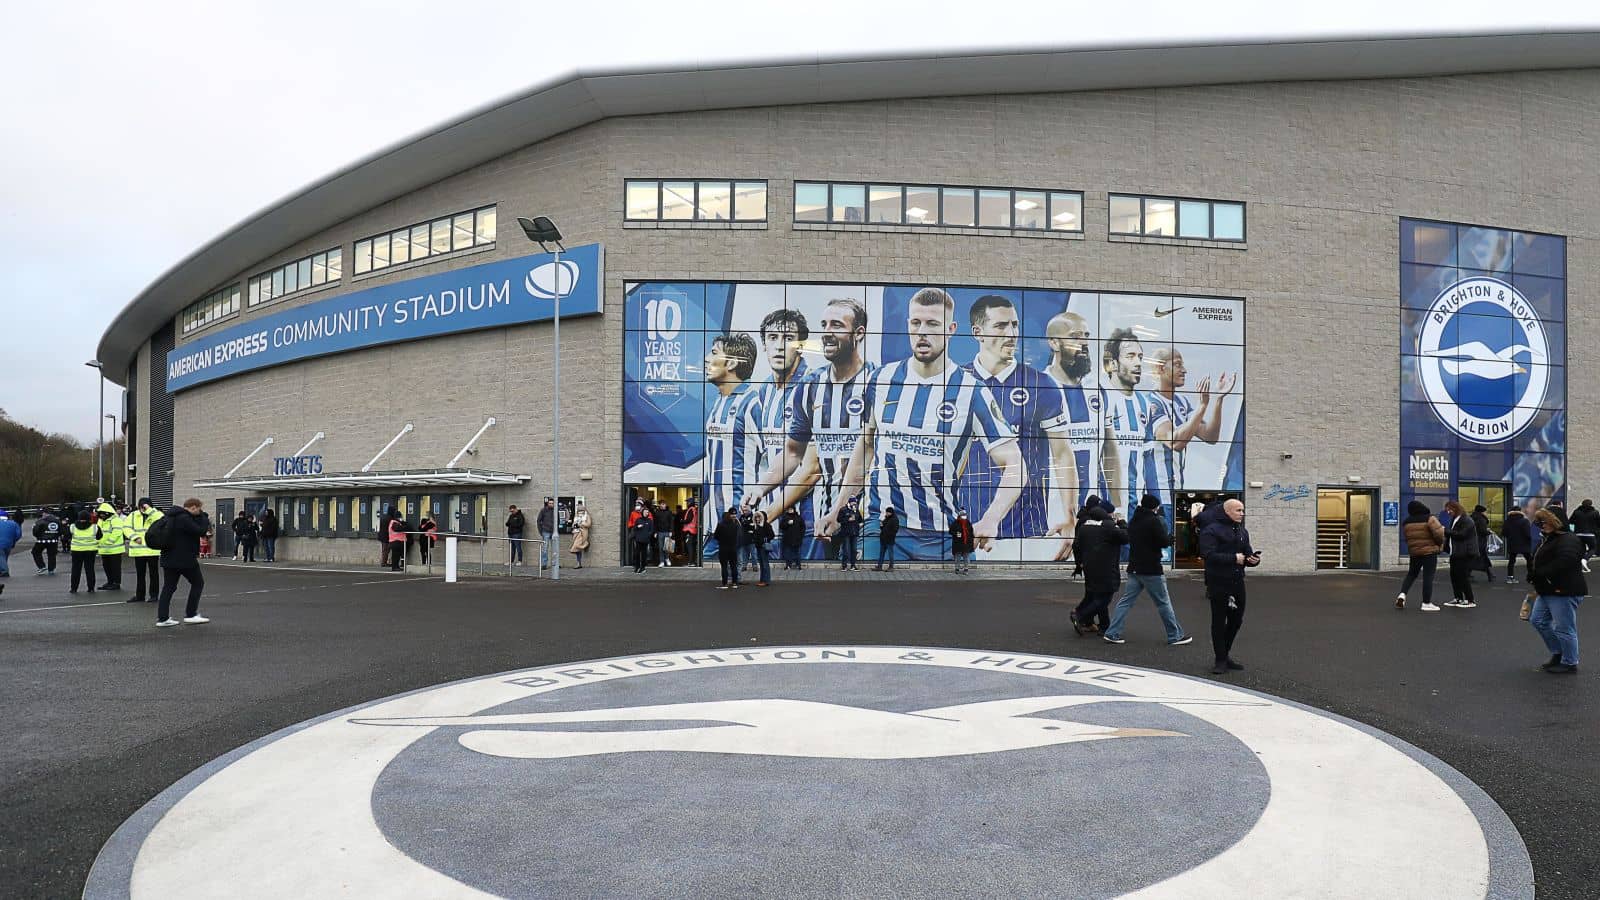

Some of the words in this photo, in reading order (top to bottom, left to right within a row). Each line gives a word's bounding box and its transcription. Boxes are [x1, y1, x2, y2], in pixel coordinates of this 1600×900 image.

[1192, 306, 1232, 315] AMERICAN
[1434, 285, 1491, 325] BRIGHTON
[1497, 290, 1505, 302] &
[1509, 297, 1536, 331] HOVE
[645, 299, 681, 340] 10
[169, 348, 212, 380] AMERICAN
[214, 331, 268, 365] EXPRESS
[273, 304, 388, 348] COMMUNITY
[394, 279, 511, 324] STADIUM
[645, 341, 681, 356] YEARS
[644, 362, 681, 380] AMEX
[1460, 418, 1509, 436] ALBION
[820, 442, 856, 452] EXPRES
[885, 430, 944, 448] AMERICAN
[891, 441, 944, 457] EXPRESS
[273, 455, 323, 475] TICKETS
[1410, 454, 1449, 471] North
[1410, 470, 1449, 481] Reception
[504, 650, 857, 688] BRIGHTON
[898, 651, 934, 661] &
[970, 656, 1145, 683] HOVE
